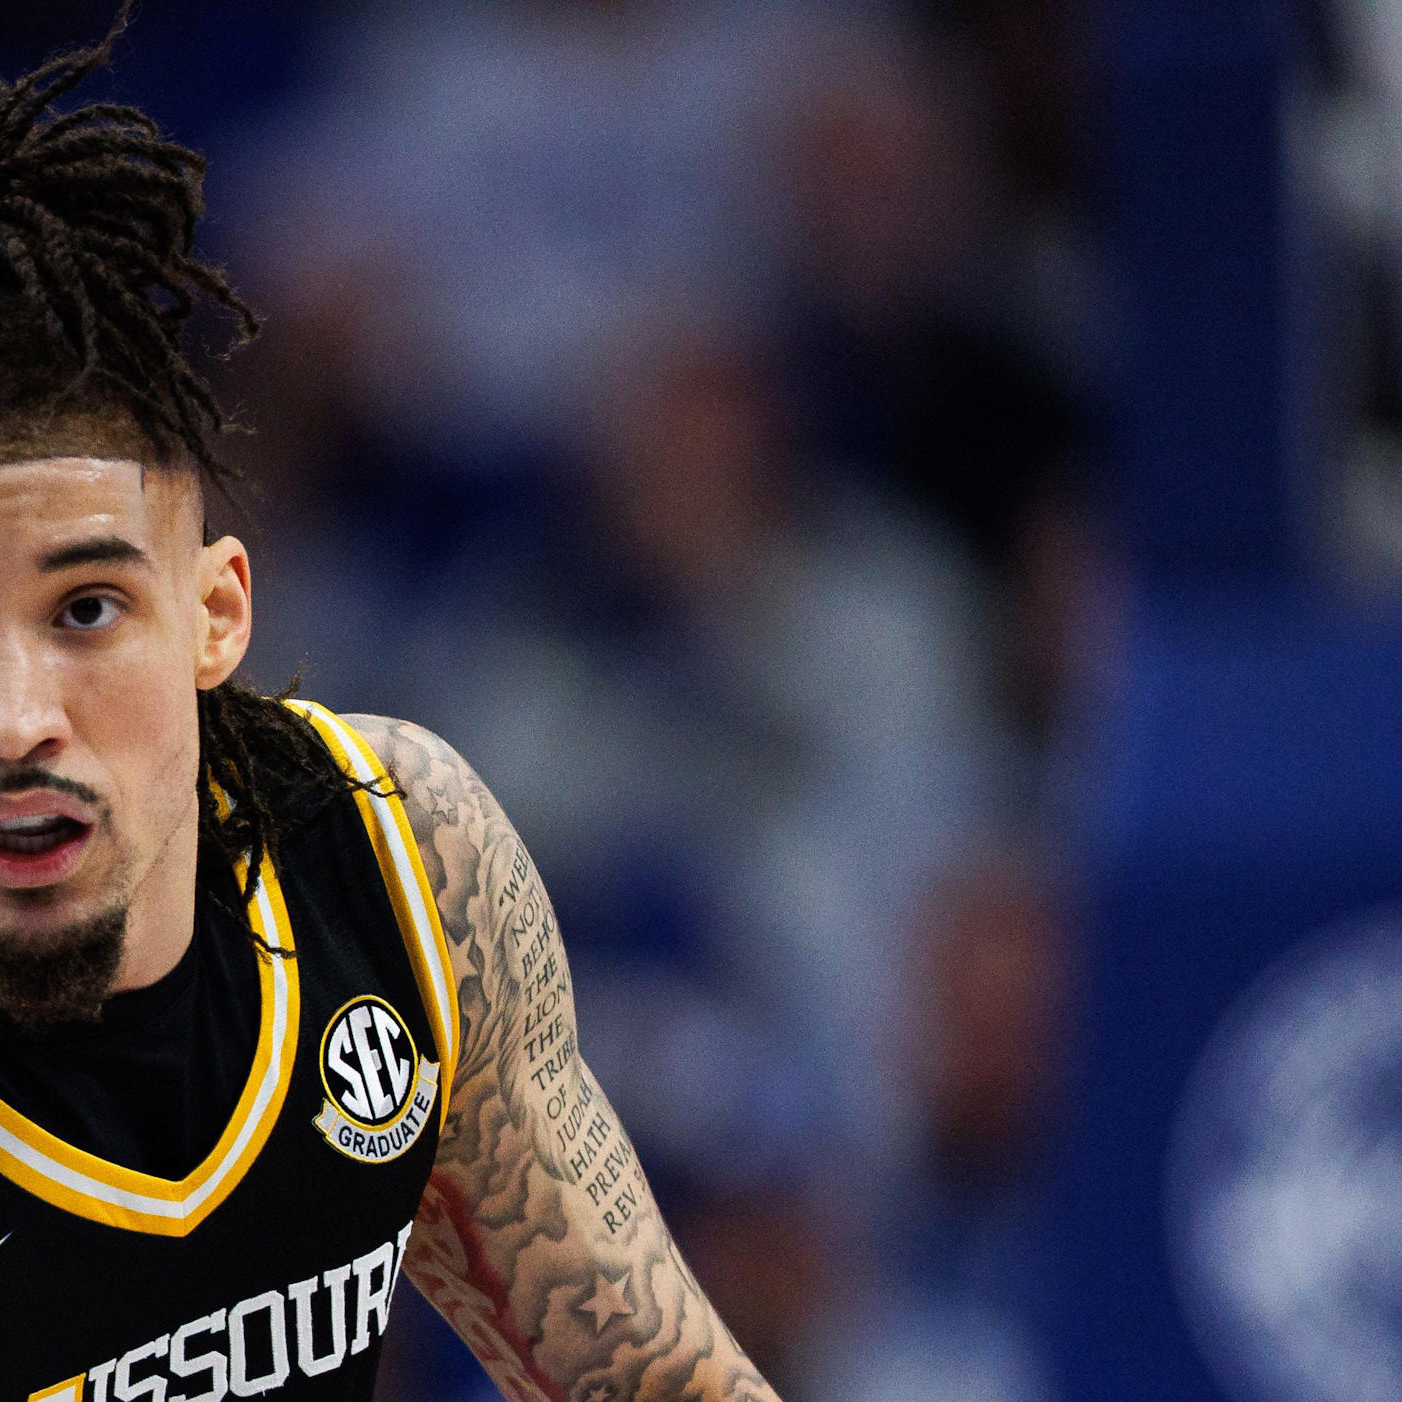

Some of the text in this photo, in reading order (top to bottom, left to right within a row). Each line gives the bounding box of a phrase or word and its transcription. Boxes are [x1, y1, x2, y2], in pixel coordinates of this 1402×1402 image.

[522, 909, 557, 980] BEHO
[524, 951, 558, 1006] THE
[524, 972, 567, 1037] LION
[327, 1005, 411, 1121] SEC
[524, 1013, 564, 1063] THE
[531, 1031, 576, 1091] TRIBE
[338, 1092, 431, 1158] GRADUATE
[547, 1083, 567, 1120] OF
[557, 1078, 593, 1153] JUDAH
[570, 1112, 612, 1180] HATH
[585, 1140, 632, 1207] PREVA
